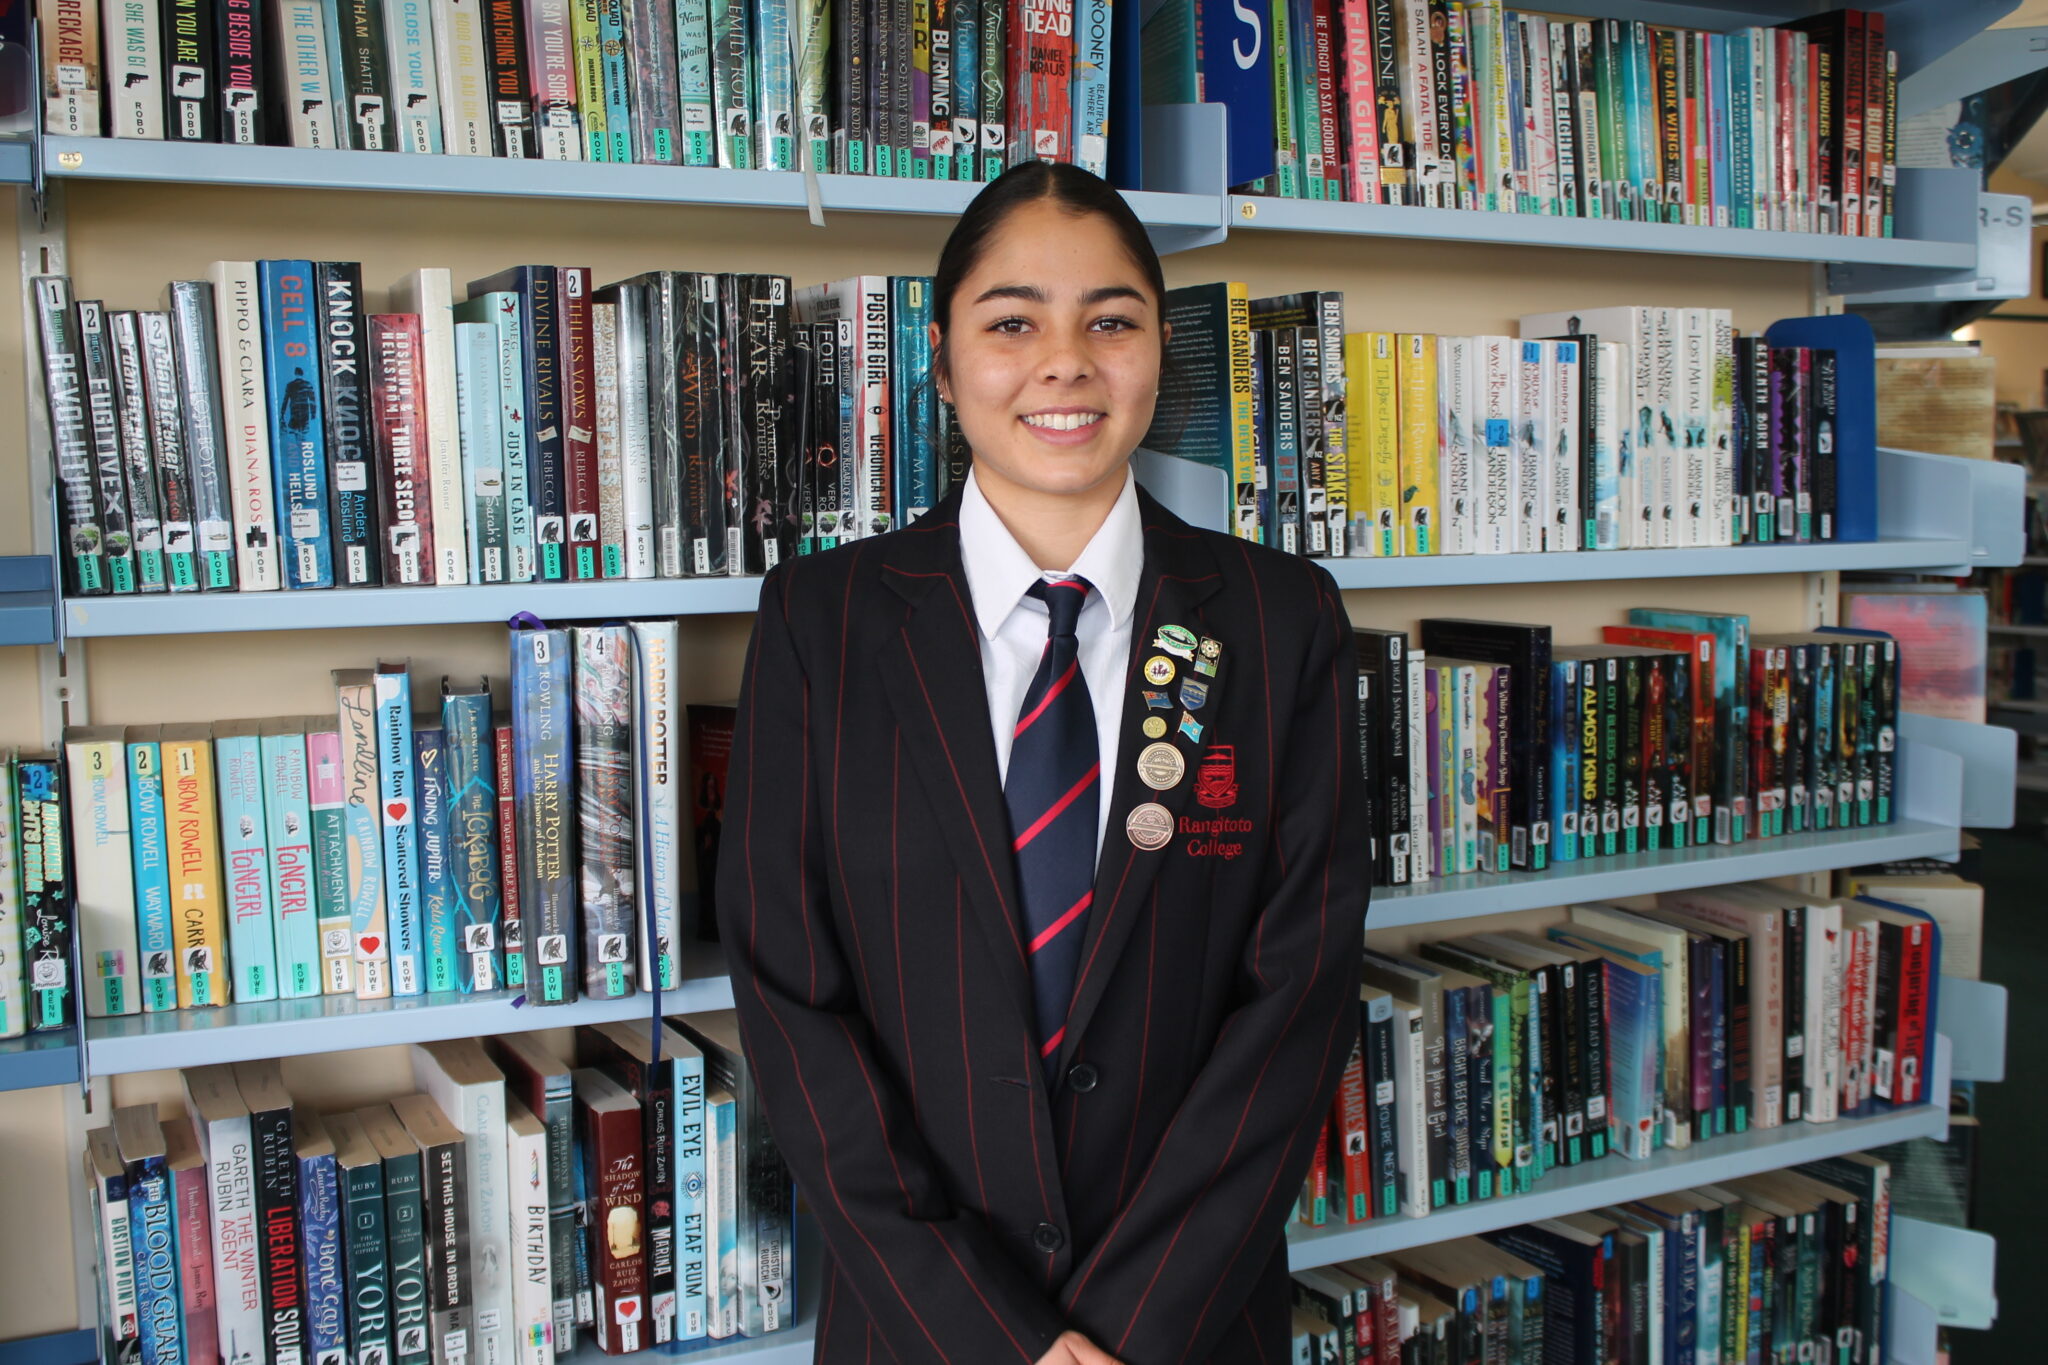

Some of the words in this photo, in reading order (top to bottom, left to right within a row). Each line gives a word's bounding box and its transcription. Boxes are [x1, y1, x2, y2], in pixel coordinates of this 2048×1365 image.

[229, 13, 252, 58] BESIDE
[293, 7, 313, 29] THE
[1025, 10, 1071, 37] DEAD
[1232, 0, 1262, 70] S
[1316, 15, 1328, 29] HE
[296, 34, 319, 77] OTHER
[407, 52, 424, 89] YOUR
[1030, 64, 1065, 76] KRAUS
[1031, 48, 1065, 63] DANIEL
[1317, 32, 1330, 71] FORGOT
[1350, 12, 1368, 92] FINAL
[1436, 52, 1447, 92] LOCK
[932, 29, 950, 116] BURNING
[1319, 75, 1331, 91] TO
[1664, 71, 1677, 112] DARK
[1321, 93, 1333, 115] SAY
[1418, 76, 1431, 117] FATAL
[1439, 96, 1450, 137] EVERY
[1820, 77, 1831, 137] SANDERS
[135, 101, 145, 135] ROBO
[186, 103, 195, 137] ROBO
[416, 121, 426, 152] ROBO
[1421, 121, 1433, 150] TIDE
[1845, 117, 1862, 152] LAW
[1867, 108, 1882, 154] BLOOD
[1322, 118, 1336, 167] GOODBYE
[1667, 117, 1679, 161] WINGS
[280, 275, 304, 332] CELL
[569, 274, 577, 294] 2
[86, 309, 96, 328] 2
[152, 320, 162, 340] 2
[327, 280, 356, 376] KNOCK
[534, 279, 551, 350] DIVINE
[867, 292, 886, 351] POSTER
[1230, 298, 1248, 326] BEN
[1323, 300, 1340, 328] BEN
[509, 320, 519, 350] MEG
[840, 324, 848, 342] 3
[1301, 338, 1317, 367] BEN
[502, 338, 512, 392] ROSOFF
[821, 330, 836, 387] FOUR
[867, 353, 888, 390] GIRL
[1231, 329, 1250, 394] SANDERS
[1277, 345, 1290, 376] BEN
[1325, 330, 1342, 384] SANDERS
[235, 280, 250, 332] PIPPO
[244, 424, 260, 481] DIANA
[536, 357, 555, 421] RIVALS
[570, 366, 587, 419] VOWS
[1237, 400, 1250, 420] THE
[1278, 380, 1293, 451] SANDERS
[1303, 370, 1321, 437] SANDERS
[391, 426, 412, 478] THREE
[507, 431, 522, 462] JUST
[1237, 424, 1251, 464] DEVILS
[1327, 427, 1343, 448] THE
[301, 441, 318, 500] ROSLUND
[510, 467, 522, 484] IN
[543, 451, 555, 507] REBECCA
[870, 433, 886, 496] VERONICA
[1496, 453, 1508, 517] BRANDON
[1487, 447, 1497, 525] SANDERSON
[341, 491, 354, 542] Roslund
[354, 494, 366, 540] Anders
[511, 489, 526, 536] CASE
[637, 537, 646, 567] ROTH
[536, 642, 546, 661] 3
[596, 636, 604, 655] 4
[649, 638, 667, 703] HARRY
[539, 671, 552, 741] ROWLING
[1583, 688, 1598, 748] ALMOST
[389, 704, 402, 767] Rainbow
[649, 710, 668, 787] POTTER
[32, 770, 43, 790] 2
[92, 750, 102, 770] 3
[138, 750, 147, 770] 2
[182, 752, 190, 770] 1
[1582, 761, 1598, 801] KING
[534, 792, 544, 828] Prisoner
[1178, 816, 1253, 837] Rangitoto
[139, 813, 161, 870] ROWELL
[177, 818, 203, 877] ROWELL
[355, 816, 378, 869] RAINBOW
[394, 824, 410, 889] Scattered
[535, 841, 545, 880] Azkaban
[1187, 840, 1243, 860] College
[327, 814, 346, 913] ATTACHMENTS
[396, 891, 412, 952] Showers
[368, 960, 377, 992] ROWE
[477, 956, 487, 987] ROWL
[682, 1074, 701, 1116] EVIL
[1454, 1081, 1468, 1125] BEFORE
[275, 1120, 292, 1198] GARETH
[683, 1123, 701, 1158] EYE
[232, 1143, 250, 1210] GARETH
[263, 1133, 277, 1190] RUBIN
[441, 1150, 452, 1175] SET
[215, 1162, 233, 1212] RUBIN
[440, 1178, 454, 1208] THIS
[604, 1193, 642, 1207] WIND
[111, 1217, 131, 1268] BASTION
[145, 1202, 173, 1292] BLOOD
[221, 1219, 239, 1271] AGENT
[238, 1212, 253, 1243] THE
[443, 1208, 456, 1248] HOUSE
[685, 1213, 702, 1255] ETAF
[267, 1206, 297, 1309] LIBERATION
[445, 1250, 457, 1263] IN
[116, 1271, 133, 1308] POINT
[238, 1250, 259, 1312] WINTER
[446, 1265, 459, 1306] ORDER
[685, 1261, 703, 1299] RUM
